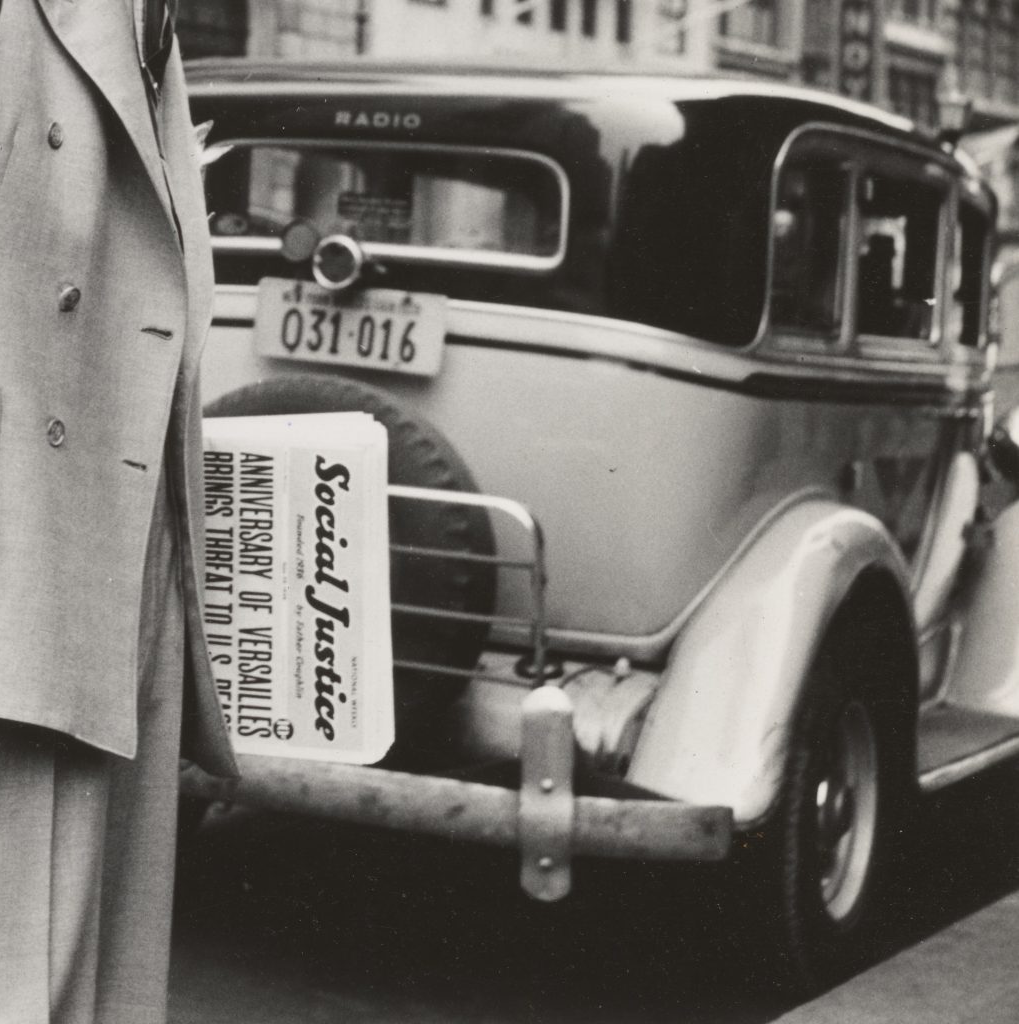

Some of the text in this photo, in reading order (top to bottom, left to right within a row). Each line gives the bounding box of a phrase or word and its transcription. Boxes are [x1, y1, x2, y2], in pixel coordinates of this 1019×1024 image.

[334, 110, 421, 129] RADIO
[203, 451, 234, 517] BRINGS
[204, 528, 233, 595] THREAT
[237, 452, 274, 738] ANNIVERSARY OF VERSAILLES
[204, 604, 233, 625] TO
[294, 513, 305, 699] Founded 1936 by Father Coughlin
[305, 455, 350, 741] Social Justice
